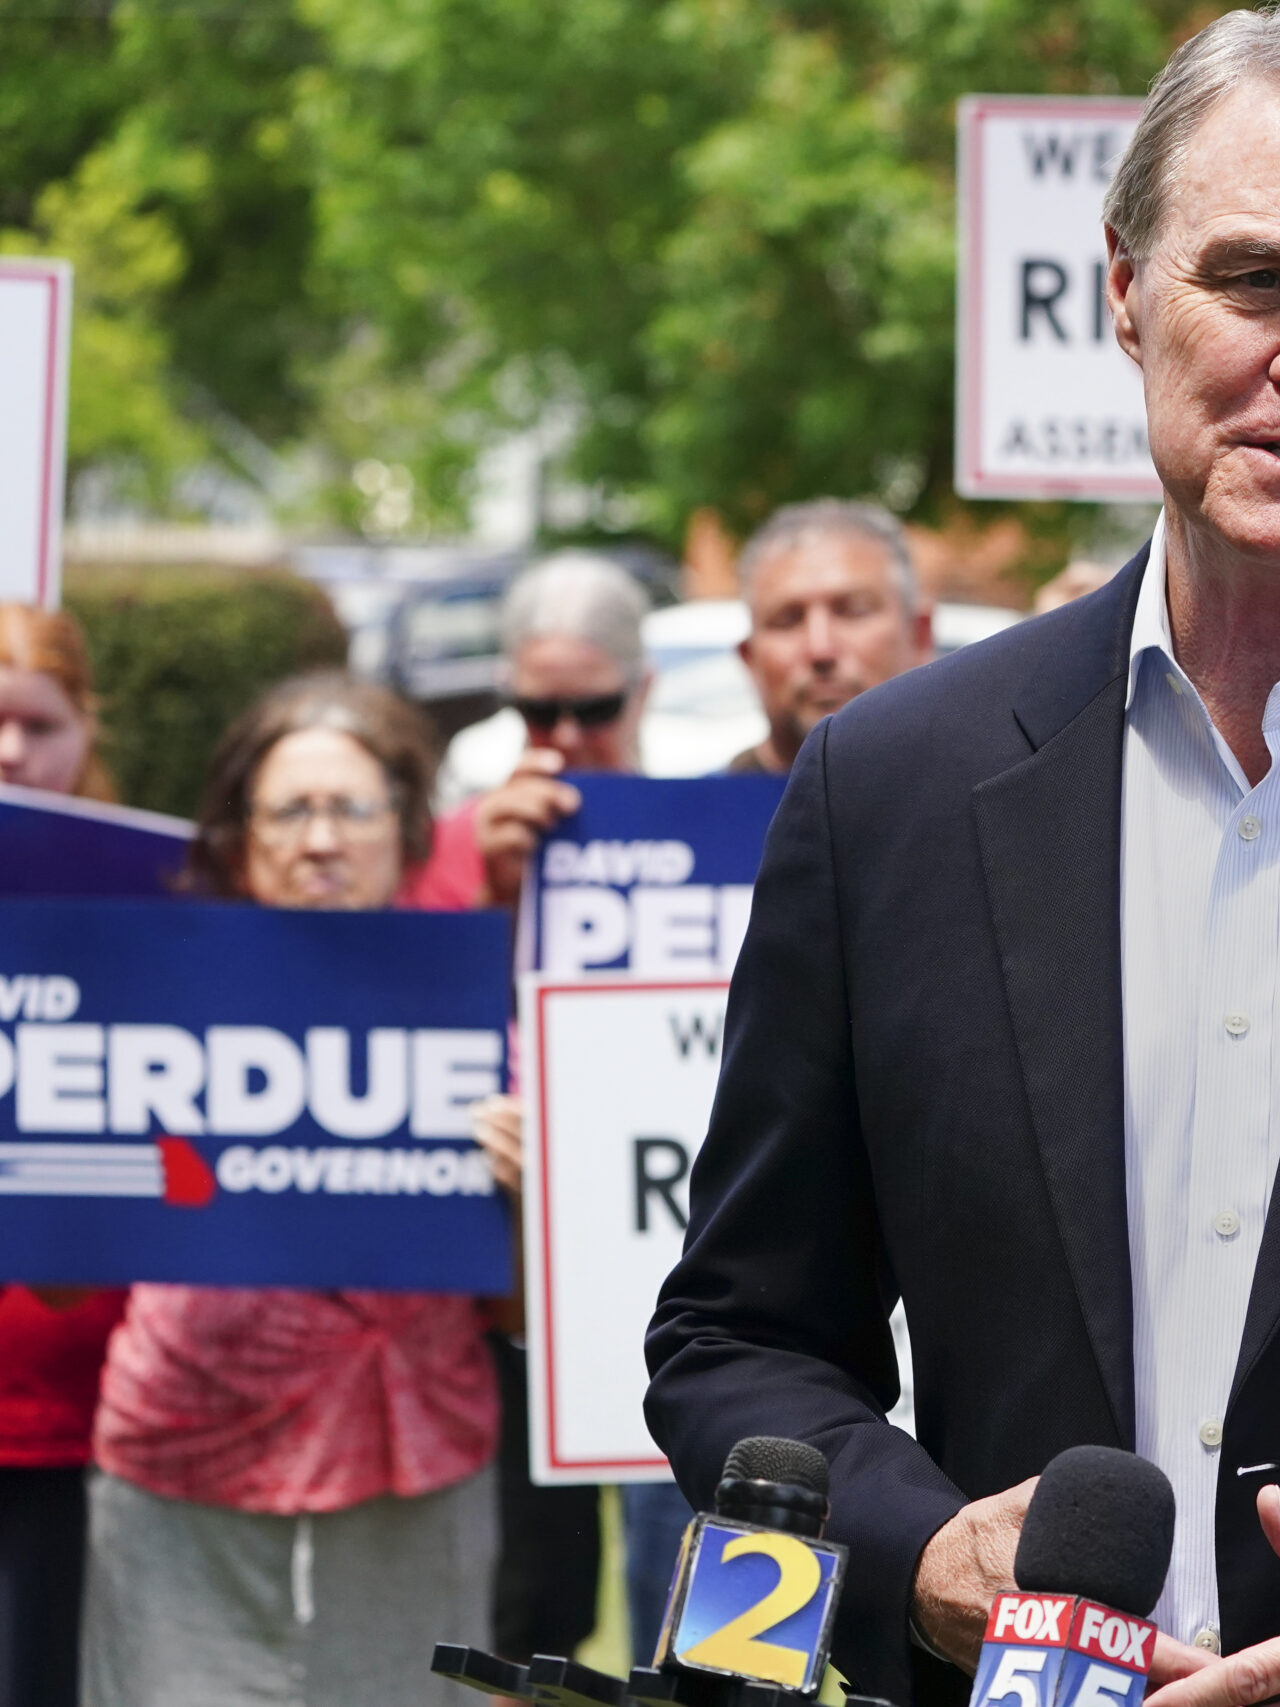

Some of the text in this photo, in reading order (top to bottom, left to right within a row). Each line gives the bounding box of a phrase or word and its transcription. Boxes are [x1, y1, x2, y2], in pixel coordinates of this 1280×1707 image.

[1020, 257, 1105, 342] RI
[543, 840, 695, 885] DAVID
[0, 1023, 503, 1140] ERDUE
[216, 1146, 494, 1196] GOVERNOR
[634, 1137, 689, 1223] R
[680, 1532, 821, 1687] 2
[994, 1597, 1066, 1641] FOX
[1078, 1607, 1152, 1668] FOX
[985, 1649, 1048, 1707] 5
